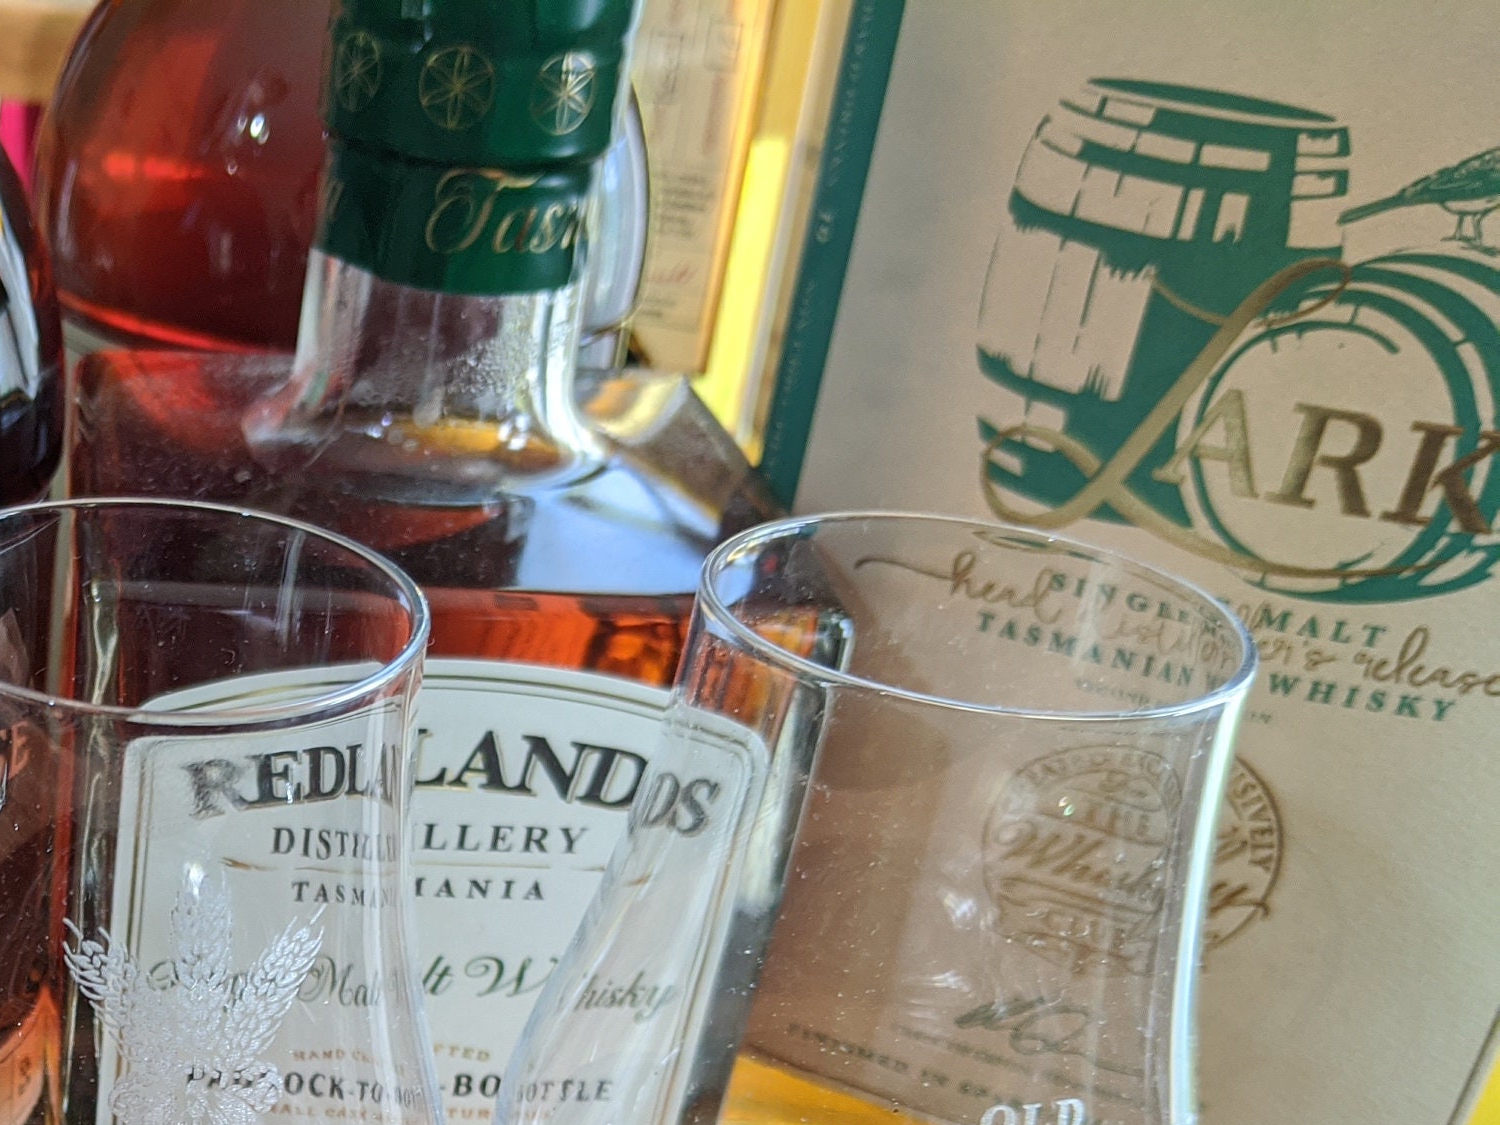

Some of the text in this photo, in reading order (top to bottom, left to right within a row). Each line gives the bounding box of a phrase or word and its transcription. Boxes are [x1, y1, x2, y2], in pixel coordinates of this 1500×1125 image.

[1260, 606, 1388, 648] MALT
[976, 610, 1456, 722] TASMANIAN WHISKY
[182, 729, 722, 838] REDLANDS
[271, 823, 590, 860] DISTILLERY
[291, 875, 546, 908] TASMANIA
